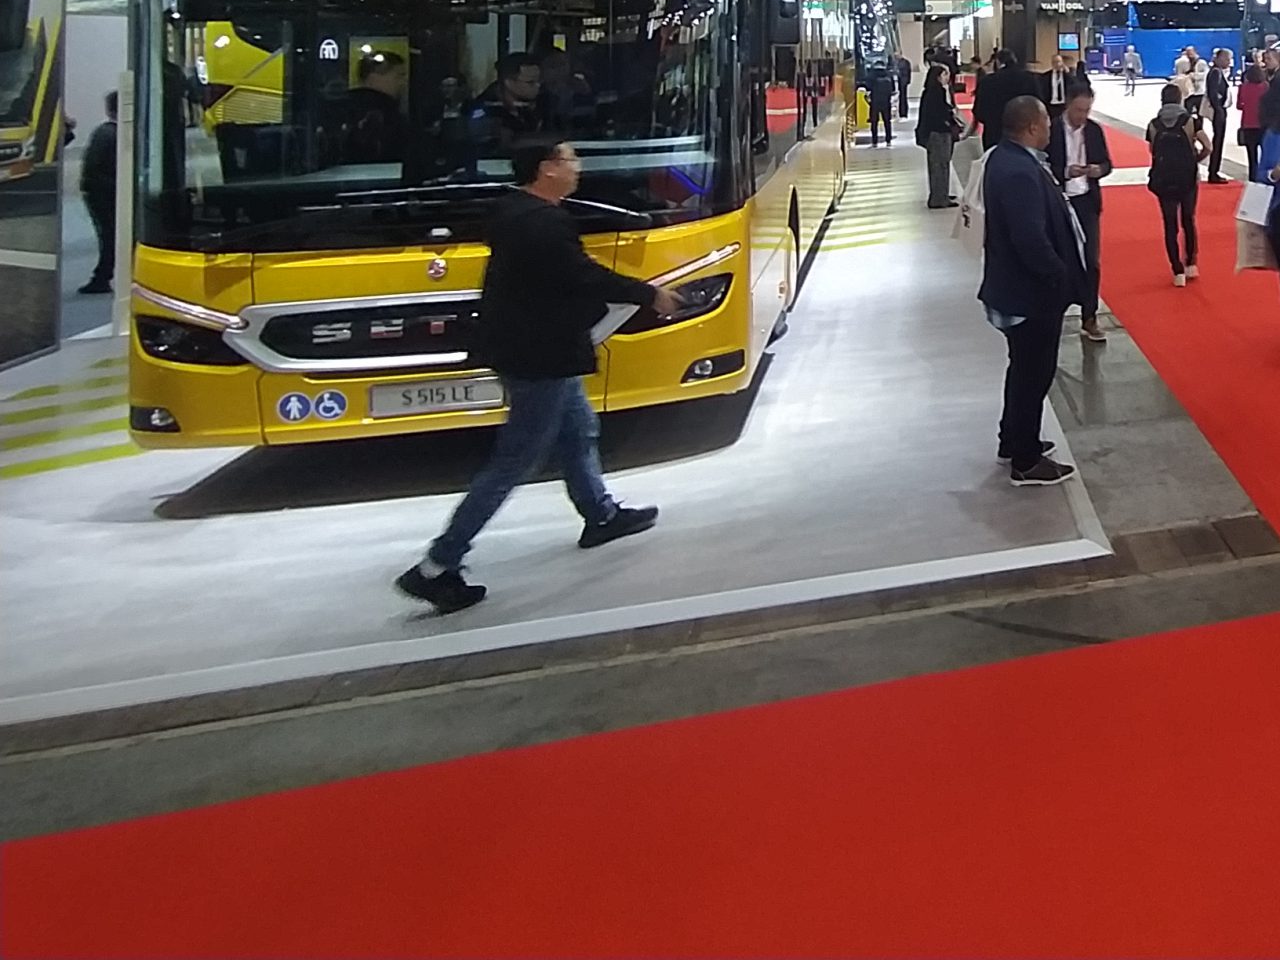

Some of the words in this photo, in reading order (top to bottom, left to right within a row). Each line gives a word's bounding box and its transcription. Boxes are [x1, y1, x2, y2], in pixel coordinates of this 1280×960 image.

[401, 389, 413, 406] S
[418, 387, 446, 404] 515
[452, 384, 475, 401] LE
